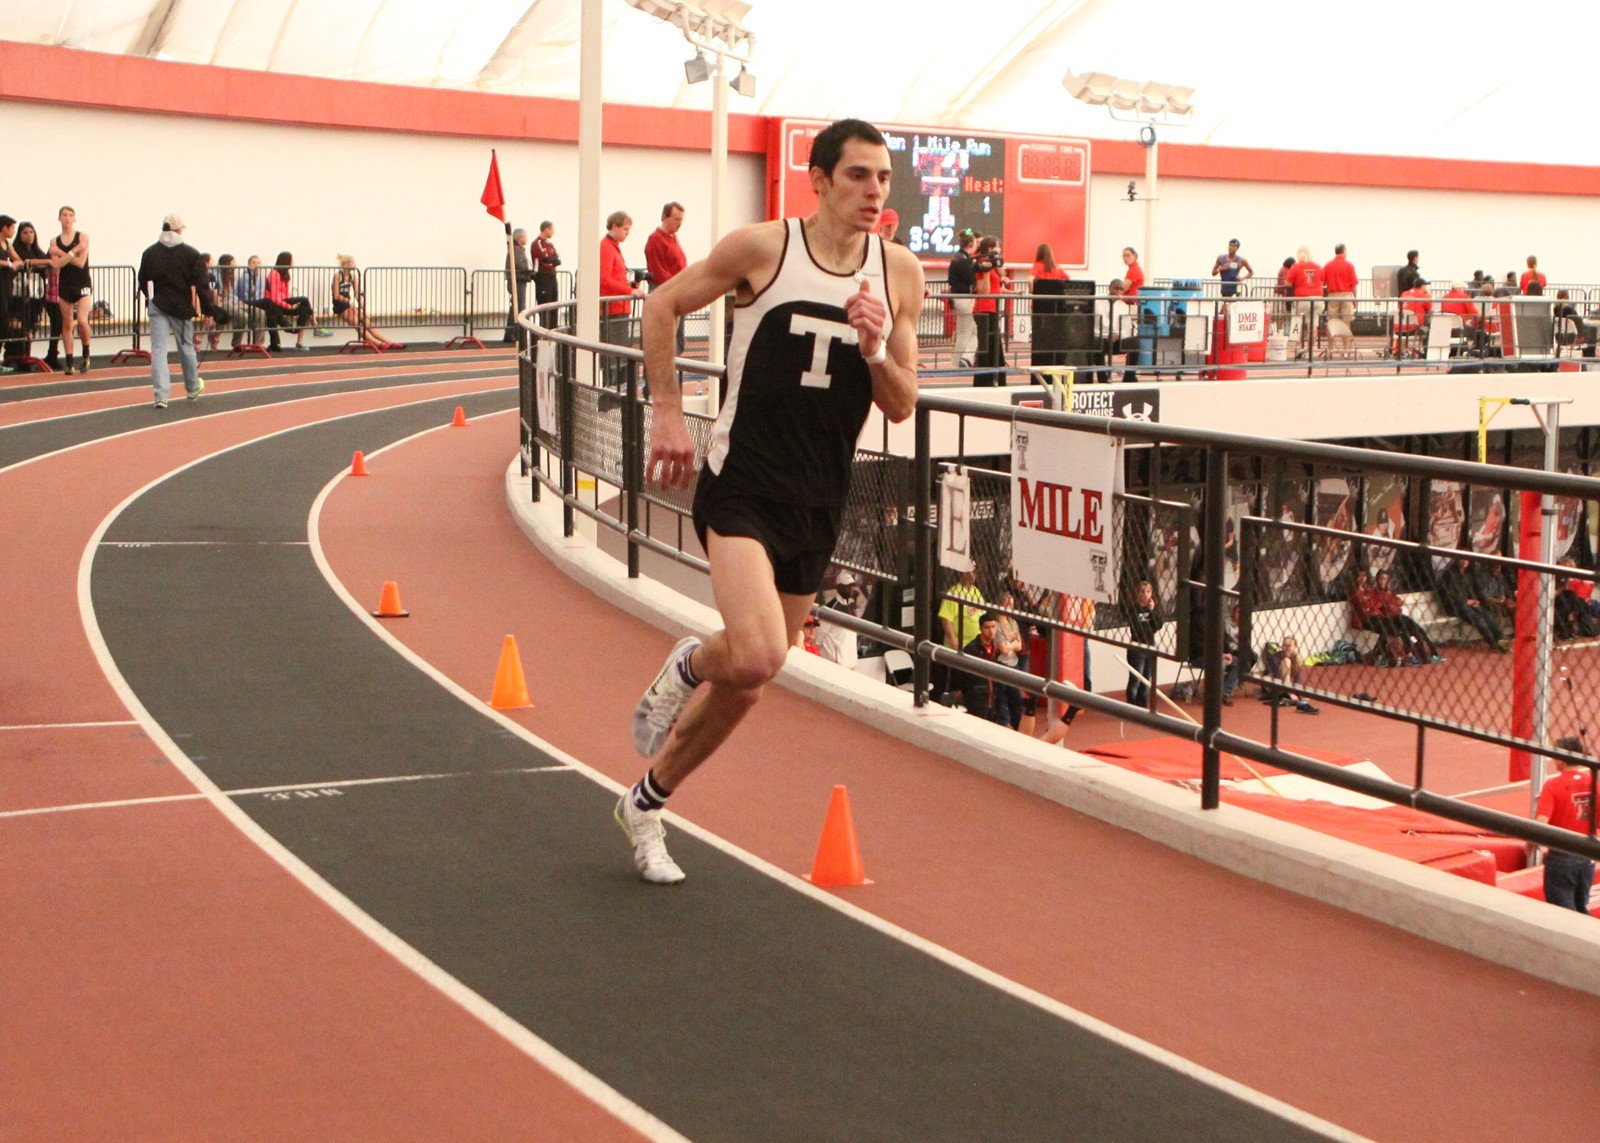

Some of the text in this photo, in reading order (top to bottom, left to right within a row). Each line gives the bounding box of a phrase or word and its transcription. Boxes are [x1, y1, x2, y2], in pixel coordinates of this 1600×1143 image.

[964, 175, 1003, 193] Heat:
[1237, 312, 1258, 323] DMR
[789, 313, 860, 389] T
[1071, 391, 1115, 409] ROTECT
[1017, 476, 1104, 544] MILE
